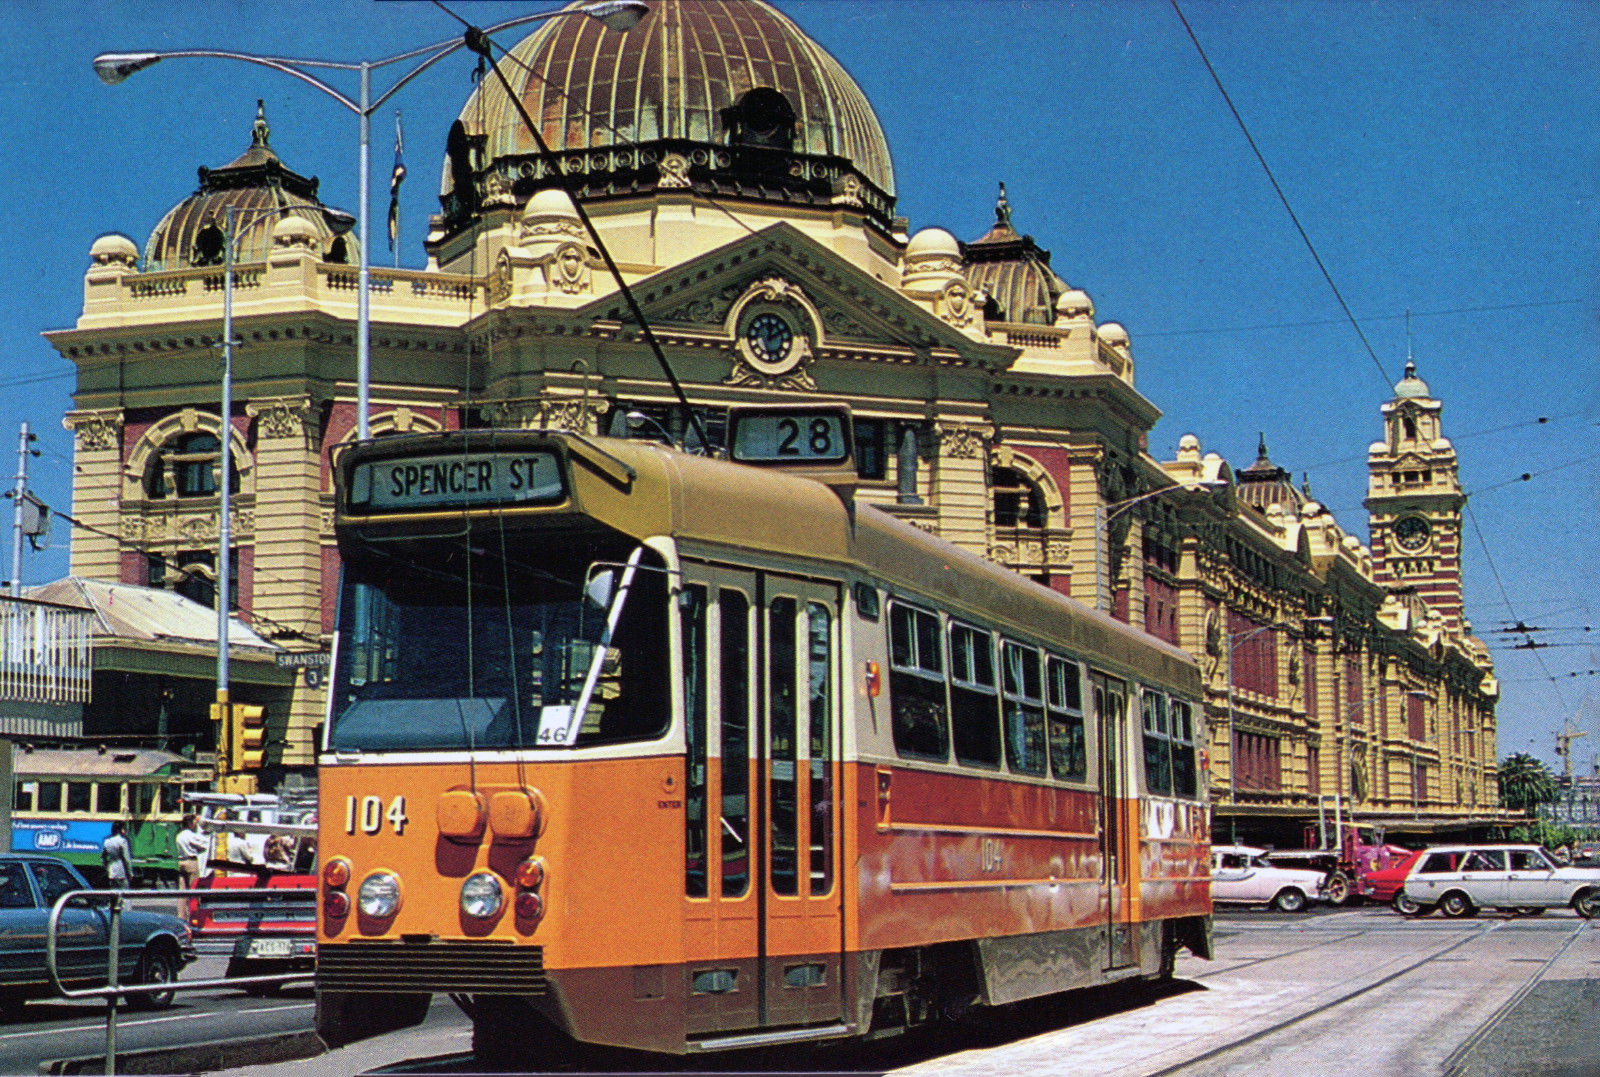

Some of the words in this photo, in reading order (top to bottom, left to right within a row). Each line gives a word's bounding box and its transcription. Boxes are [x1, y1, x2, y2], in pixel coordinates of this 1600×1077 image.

[778, 417, 831, 455] 28
[391, 461, 493, 497] SPENCER
[510, 458, 539, 490] ST
[538, 727, 567, 743] 46
[345, 795, 409, 836] 104
[981, 838, 1003, 873] 104
